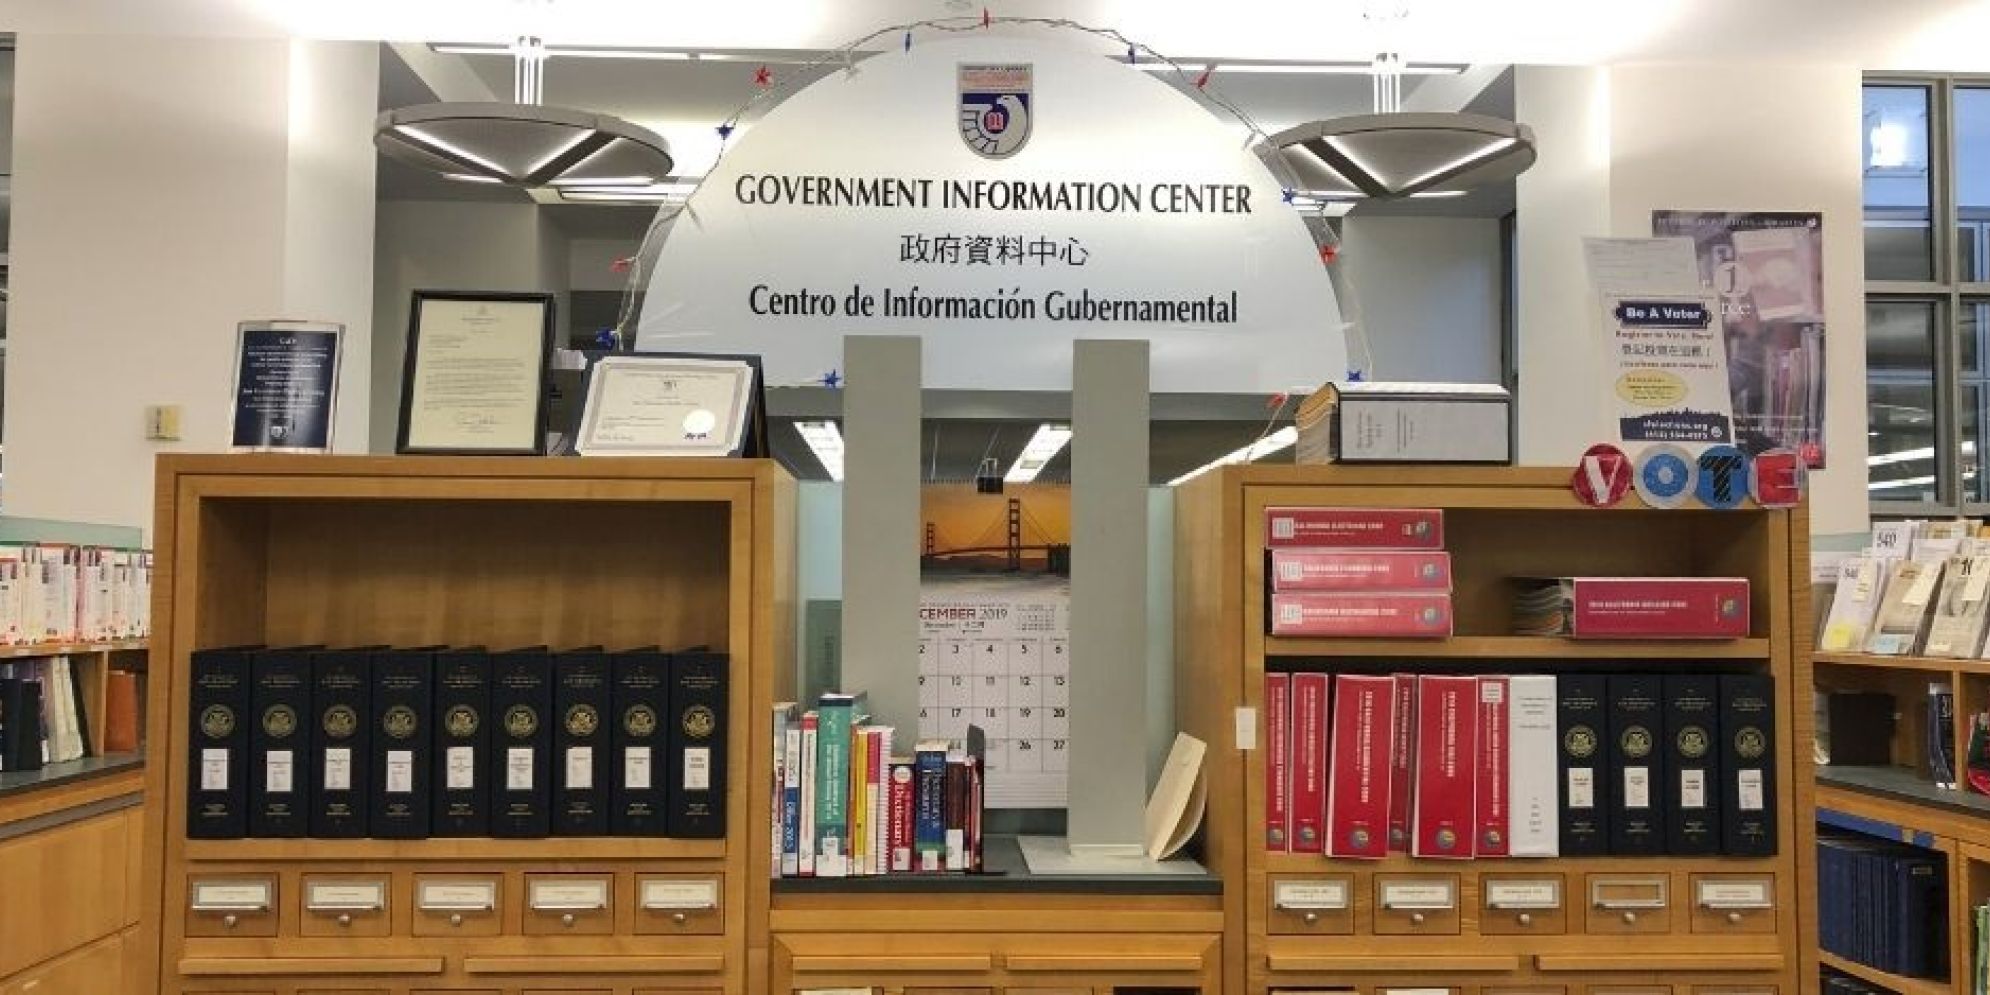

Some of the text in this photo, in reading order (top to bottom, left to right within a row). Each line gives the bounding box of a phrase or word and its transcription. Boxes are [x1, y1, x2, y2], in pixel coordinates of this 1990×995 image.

[735, 173, 1252, 214] GOVERNMENT INFORMATION CENTER
[900, 232, 1089, 267] 政府資料中心
[749, 283, 1238, 324] Centro de Información Gubernamental
[1626, 306, 1702, 320] Be A Voter
[919, 607, 977, 621] CEMBER
[979, 608, 1009, 621] 2019
[918, 645, 926, 654] 2
[952, 645, 960, 654] 3
[986, 645, 994, 654] 4
[1021, 645, 1028, 654] 5
[1019, 676, 1031, 686] 12
[919, 708, 1066, 718] 6 17 18 19 20
